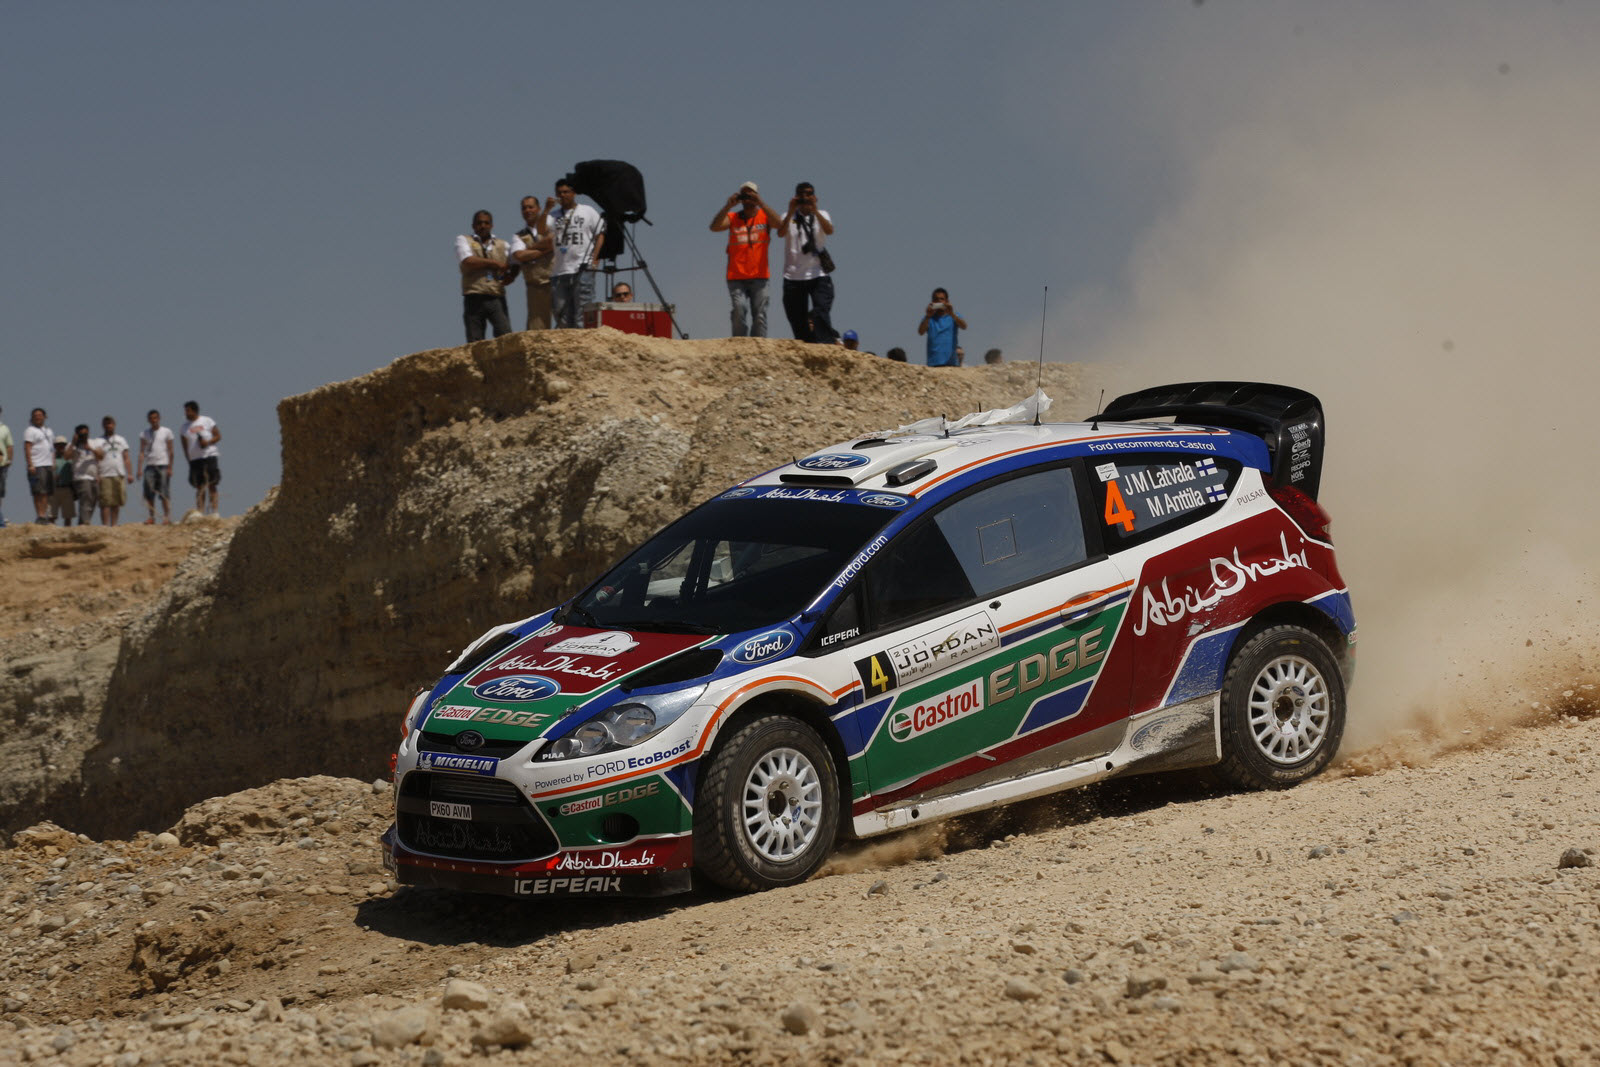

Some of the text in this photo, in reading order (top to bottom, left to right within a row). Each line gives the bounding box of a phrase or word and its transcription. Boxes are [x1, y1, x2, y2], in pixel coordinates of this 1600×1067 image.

[1088, 440, 1217, 452] Ford recommends Castrol
[806, 455, 860, 469] Ford
[1147, 461, 1196, 490] Latvala
[866, 495, 900, 507] Ford
[1105, 480, 1137, 532] 4
[1146, 487, 1206, 518] M Anttila
[1236, 487, 1267, 507] PULSAR
[834, 534, 889, 589] wrcford.com
[744, 635, 784, 661] Ford
[821, 627, 861, 647] ICEPEAK
[898, 623, 994, 670] JORDAN
[950, 636, 995, 660] RALLY
[894, 640, 928, 658] 2011
[870, 655, 889, 693] 4
[912, 625, 1108, 733] Castrol EDGE
[482, 677, 547, 699] Ford
[442, 706, 552, 728] Castrol EDGE
[460, 734, 477, 746] Ford
[434, 756, 494, 771] MICHELIN
[534, 739, 691, 790] Powered by FORD EcoBoost
[542, 751, 565, 760] PIAA
[570, 781, 660, 814] Castrol EDGE
[431, 804, 471, 819] PX60 AVM
[514, 876, 622, 895] ICEPEAK
